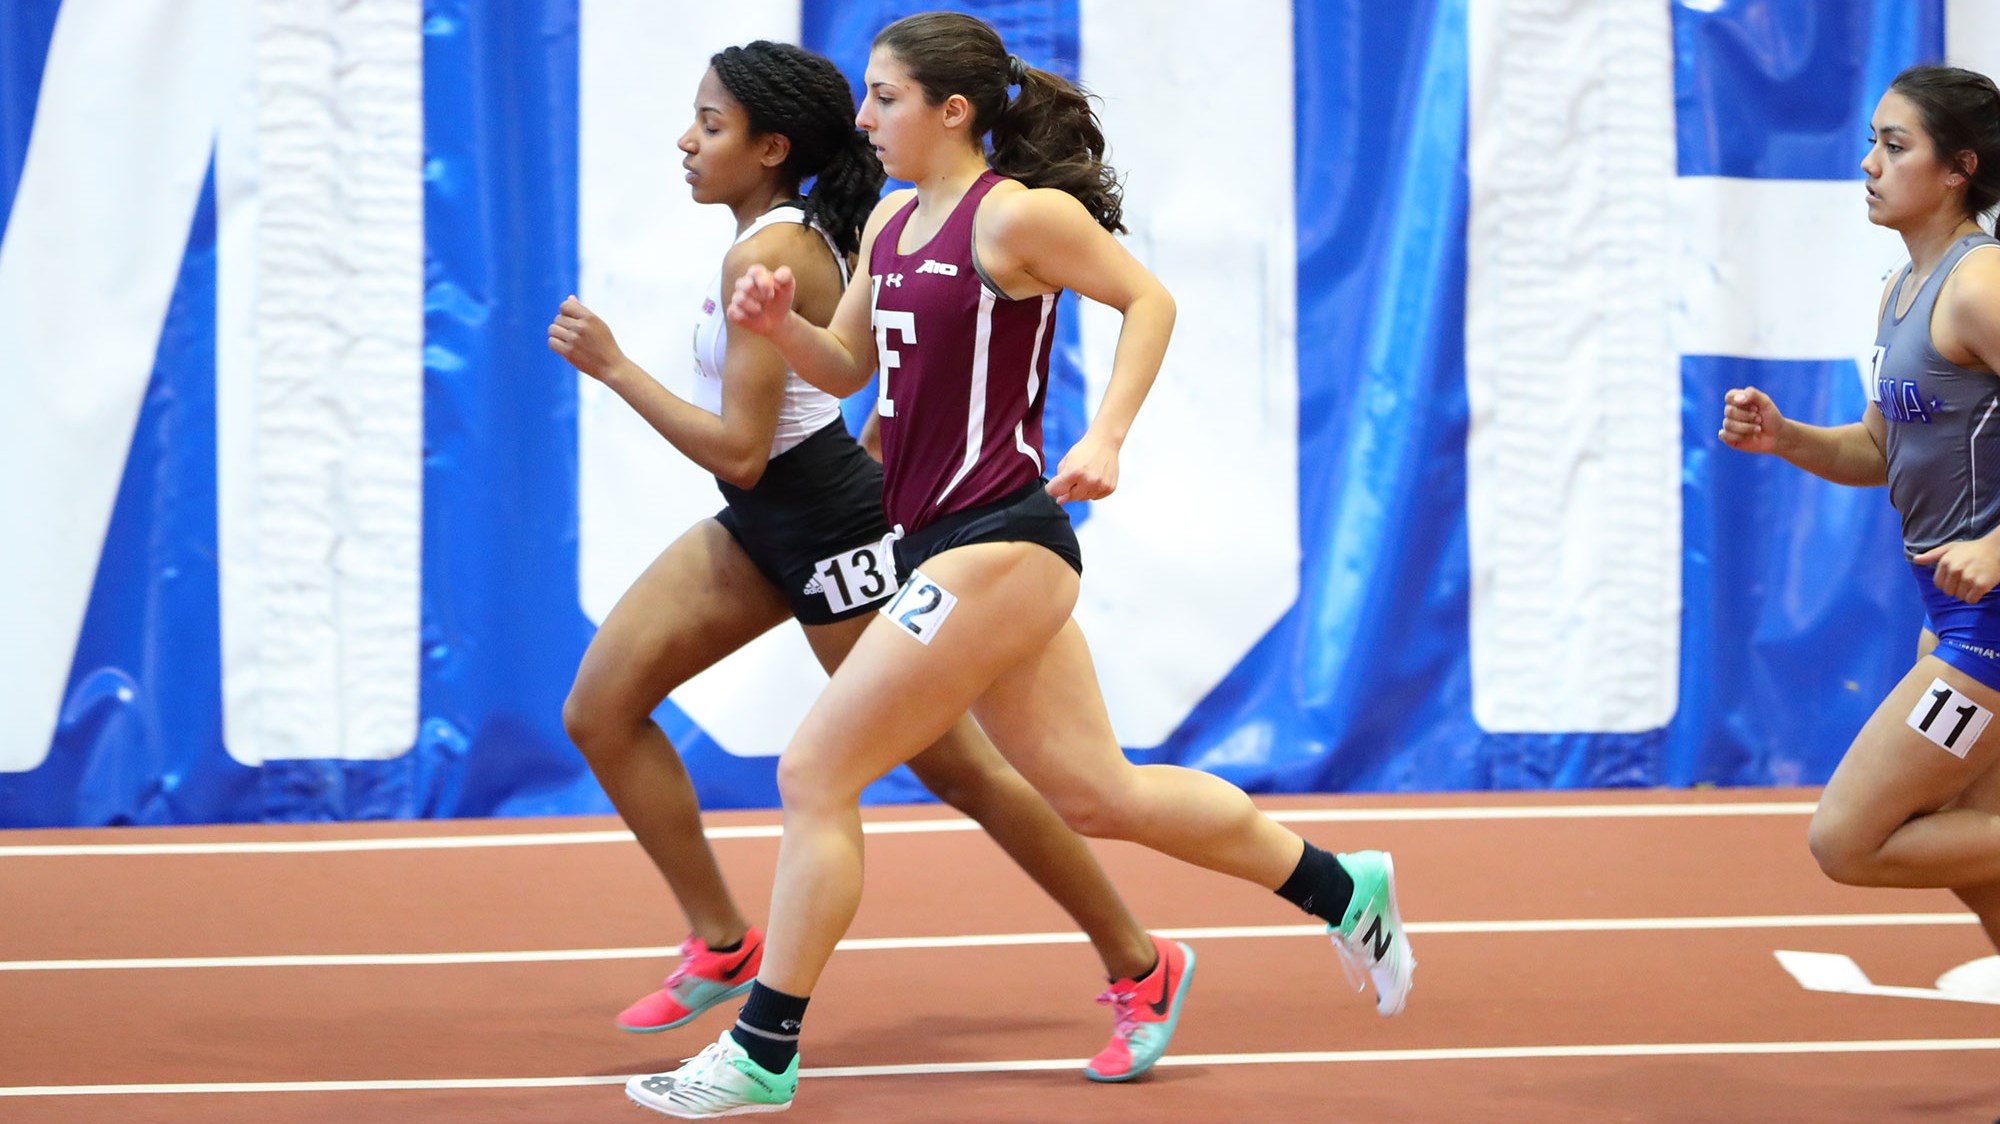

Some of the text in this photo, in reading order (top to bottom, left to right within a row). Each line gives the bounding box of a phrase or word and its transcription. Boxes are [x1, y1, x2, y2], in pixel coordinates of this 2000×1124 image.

[875, 309, 917, 418] F
[824, 549, 886, 607] 13
[1918, 688, 1978, 749] 11
